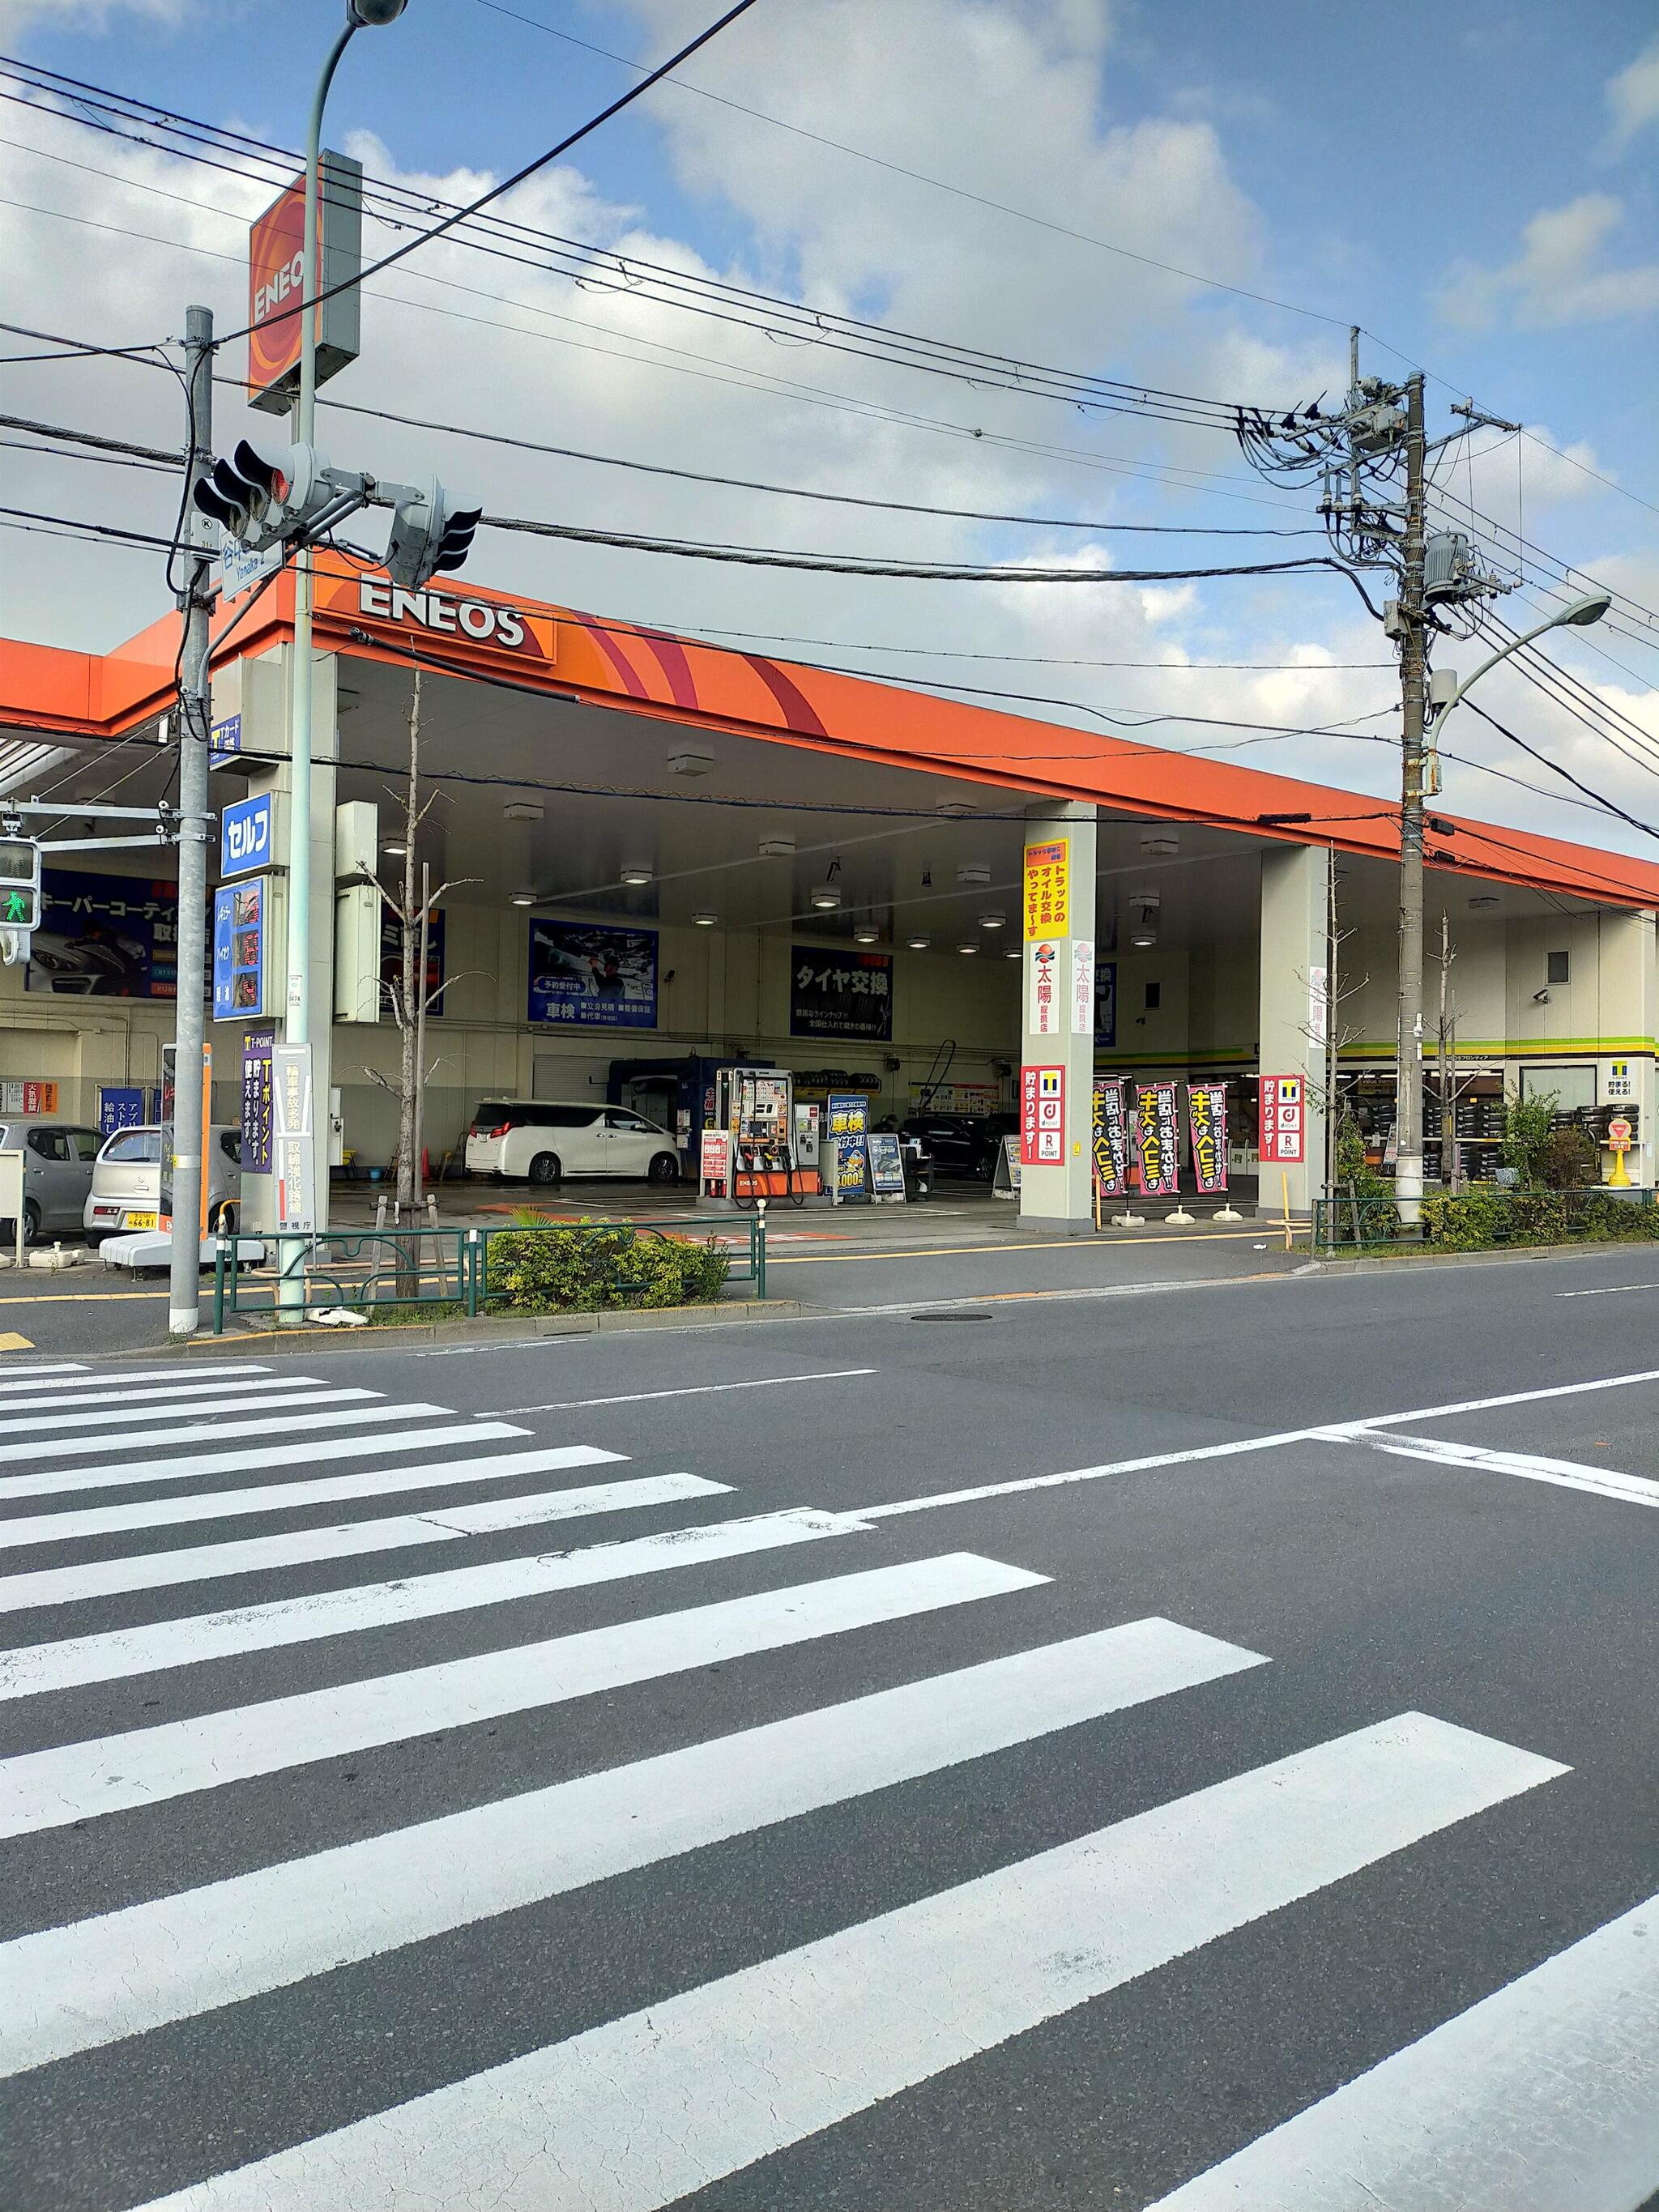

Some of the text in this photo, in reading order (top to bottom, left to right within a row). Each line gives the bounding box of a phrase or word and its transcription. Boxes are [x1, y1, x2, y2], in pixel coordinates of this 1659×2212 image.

[254, 249, 305, 323] ENEO
[237, 557, 258, 582] Yanaka
[359, 573, 527, 649] ENEOS
[228, 809, 268, 860] セルフ
[1040, 866, 1052, 924] オイル交換
[1054, 865, 1066, 923] トラックの
[796, 965, 889, 996] タイヤ交換
[1038, 965, 1052, 1004] 太陽
[1077, 964, 1090, 1004] 太陽
[545, 1002, 576, 1020] 車検
[250, 1036, 274, 1049] T-POINT
[261, 1059, 272, 1166] Tポイント
[831, 1110, 865, 1134] 車検
[1025, 1071, 1037, 1160] 貯まります!
[1264, 1080, 1275, 1157] 貯まります!
[834, 1135, 864, 1149] 付中!!
[287, 1140, 302, 1214] 取締強化路線
[133, 1218, 154, 1228] 66-81
